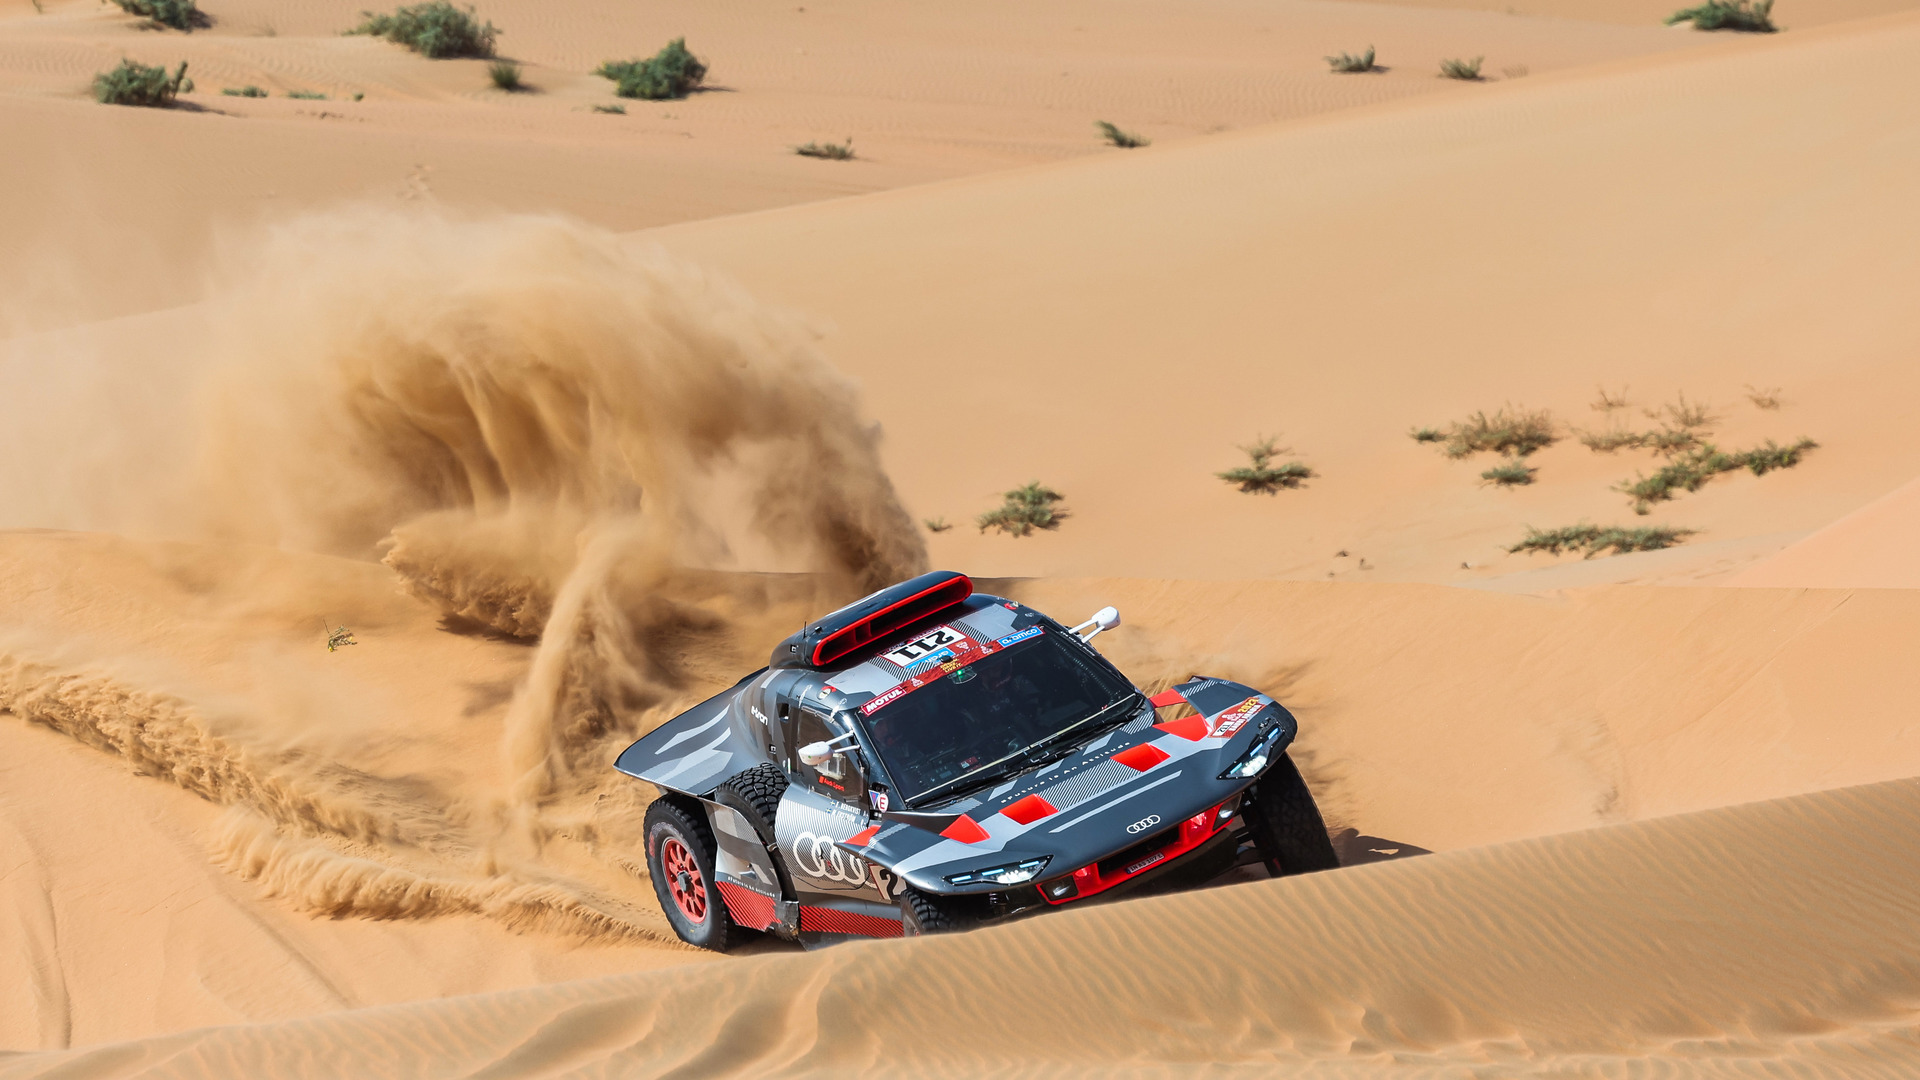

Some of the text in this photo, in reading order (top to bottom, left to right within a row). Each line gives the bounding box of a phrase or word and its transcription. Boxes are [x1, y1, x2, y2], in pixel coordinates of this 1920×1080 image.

[892, 630, 954, 660] 211
[1002, 628, 1037, 645] aramco
[865, 689, 903, 712] MOTUL
[880, 797, 886, 810] E
